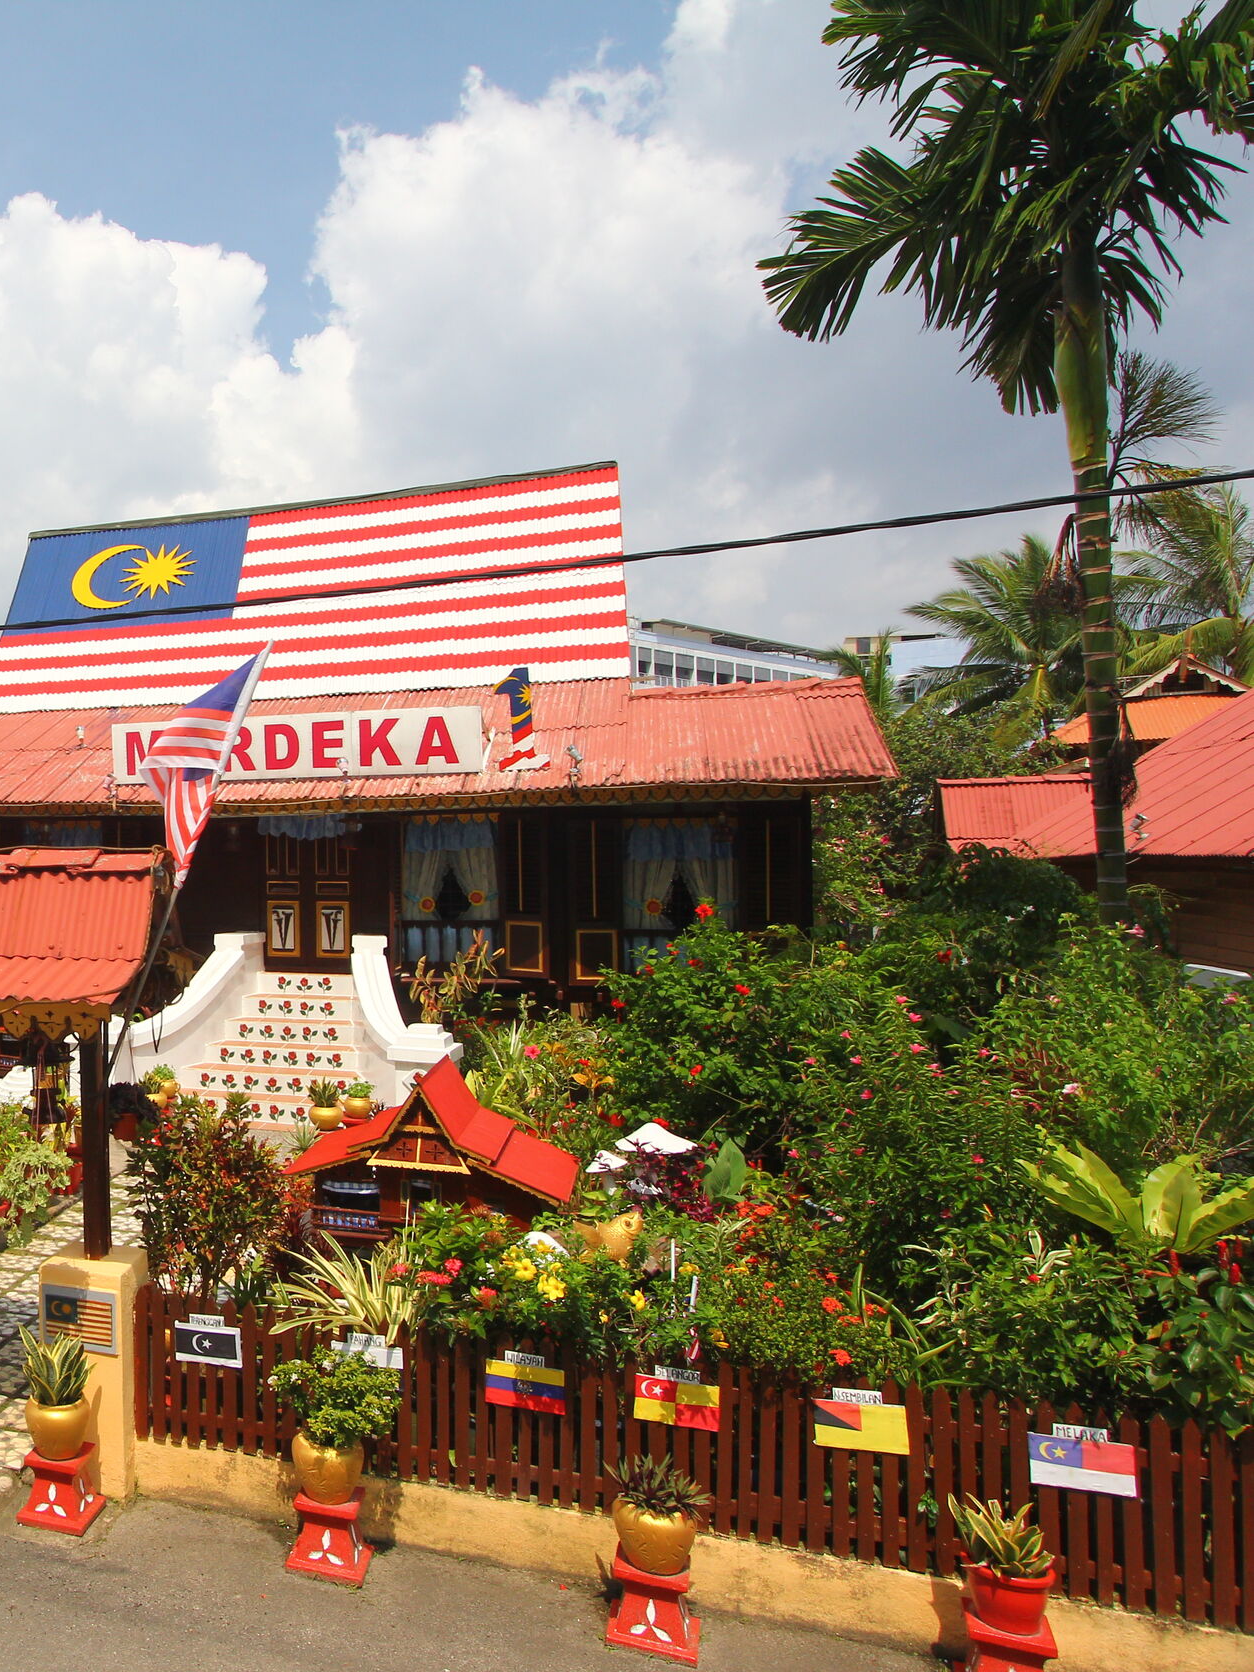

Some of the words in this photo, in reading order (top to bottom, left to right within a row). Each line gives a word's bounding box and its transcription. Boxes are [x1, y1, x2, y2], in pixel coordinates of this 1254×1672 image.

[125, 716, 460, 776] MRDEKA
[656, 1366, 700, 1382] SELANGOR
[1055, 1425, 1107, 1443] MELAKA
